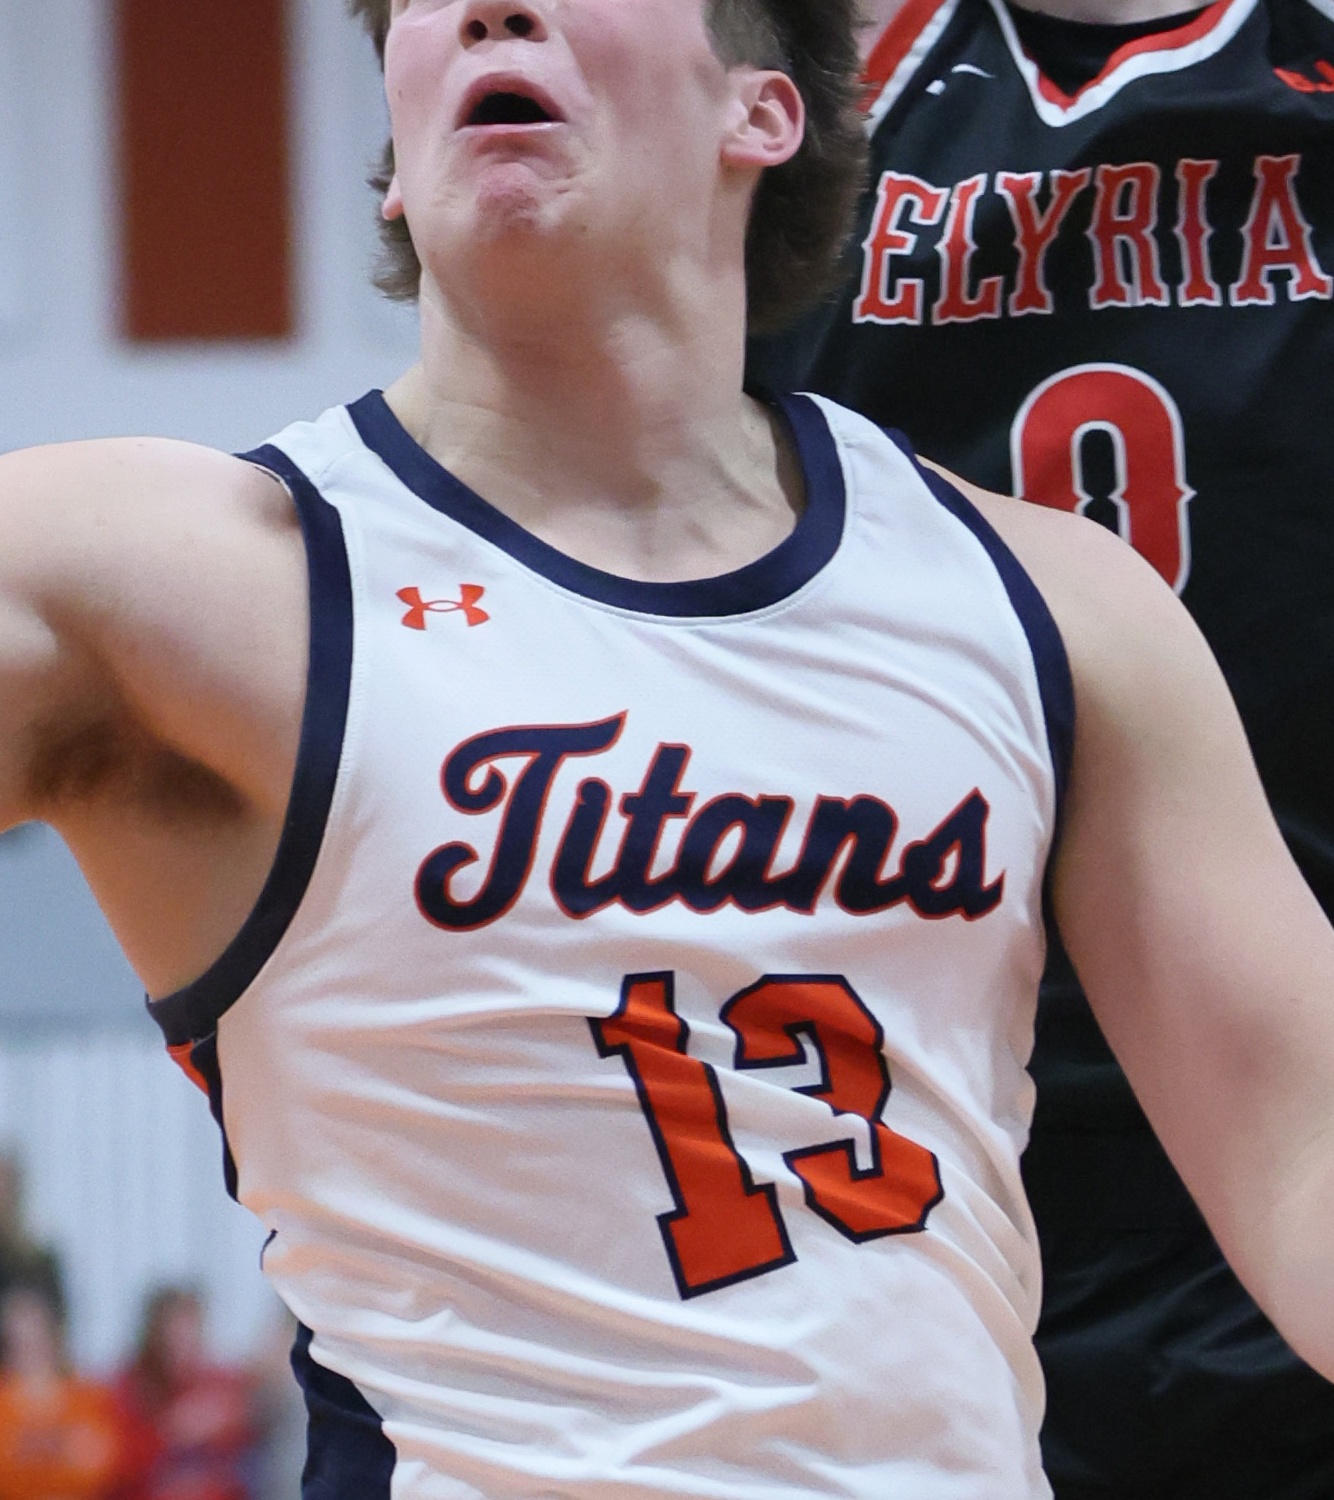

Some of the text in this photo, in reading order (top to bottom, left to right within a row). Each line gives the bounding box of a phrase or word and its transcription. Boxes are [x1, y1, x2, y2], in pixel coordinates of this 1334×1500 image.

[852, 154, 1334, 326] ELYRIA
[415, 710, 1006, 933] Titans
[588, 970, 945, 1301] 13
